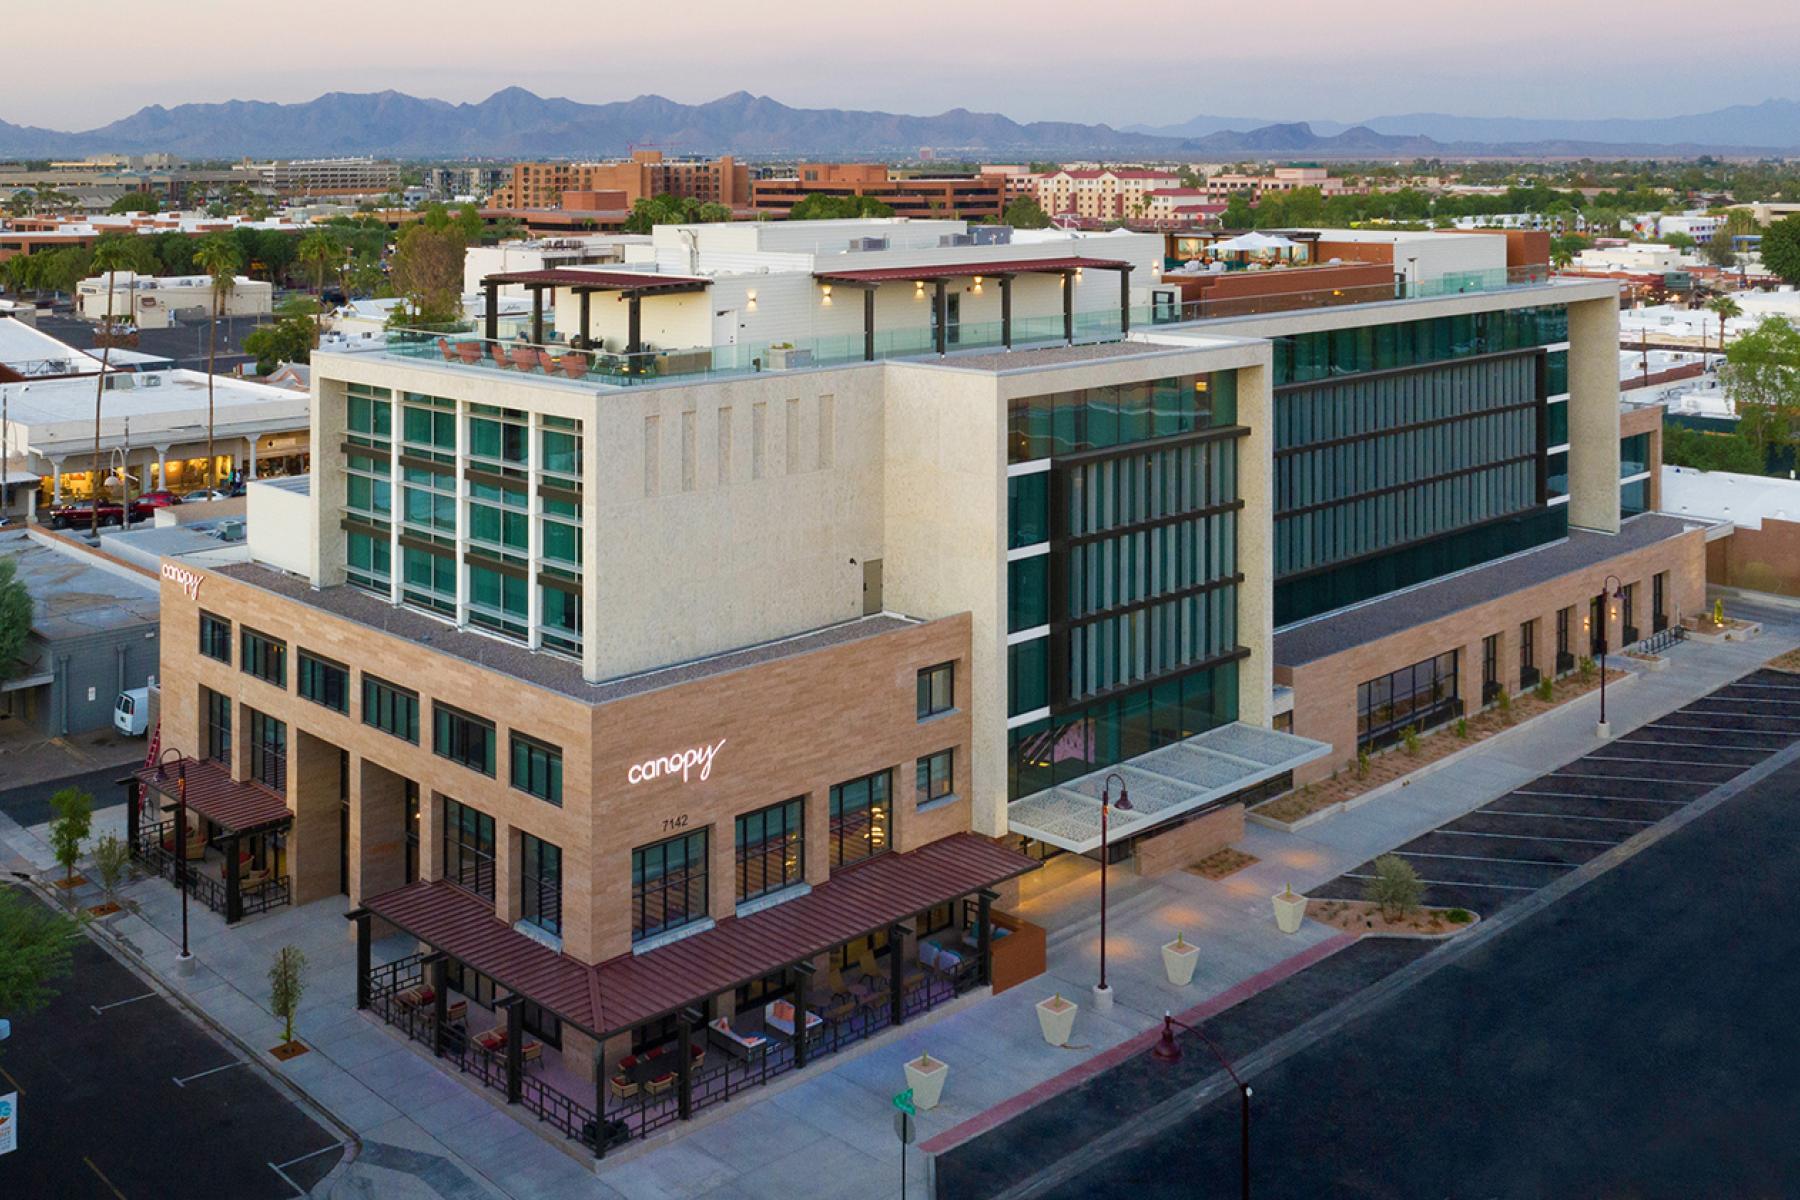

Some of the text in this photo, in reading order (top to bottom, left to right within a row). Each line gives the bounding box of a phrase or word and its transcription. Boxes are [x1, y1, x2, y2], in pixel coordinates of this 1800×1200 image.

[162, 564, 206, 600] canopy
[628, 739, 726, 784] canopy
[662, 814, 689, 832] 7142
